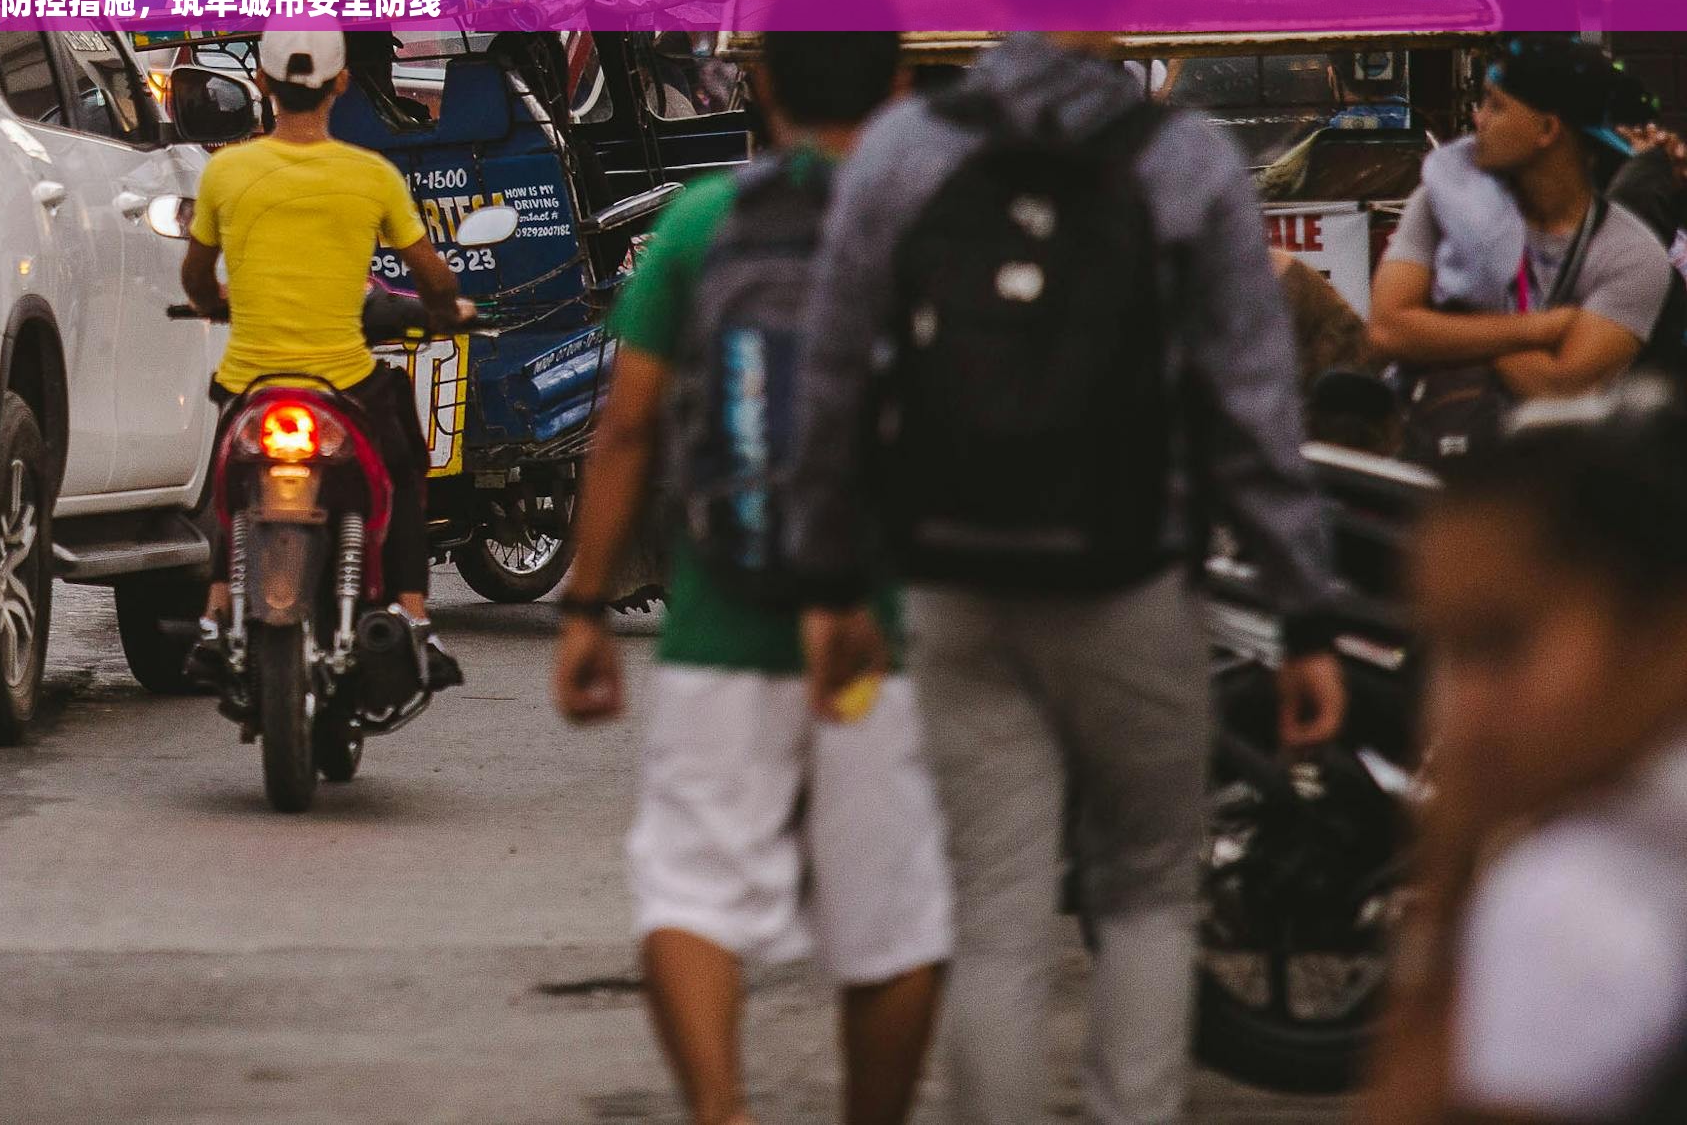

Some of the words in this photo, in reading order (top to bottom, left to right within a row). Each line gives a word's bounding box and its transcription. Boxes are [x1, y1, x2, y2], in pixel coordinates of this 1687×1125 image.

[504, 186, 527, 199] HOW
[529, 186, 537, 197] IS
[539, 184, 555, 196] MY
[514, 197, 560, 210] DRIVING
[518, 211, 550, 223] ontact
[466, 248, 496, 271] 23
